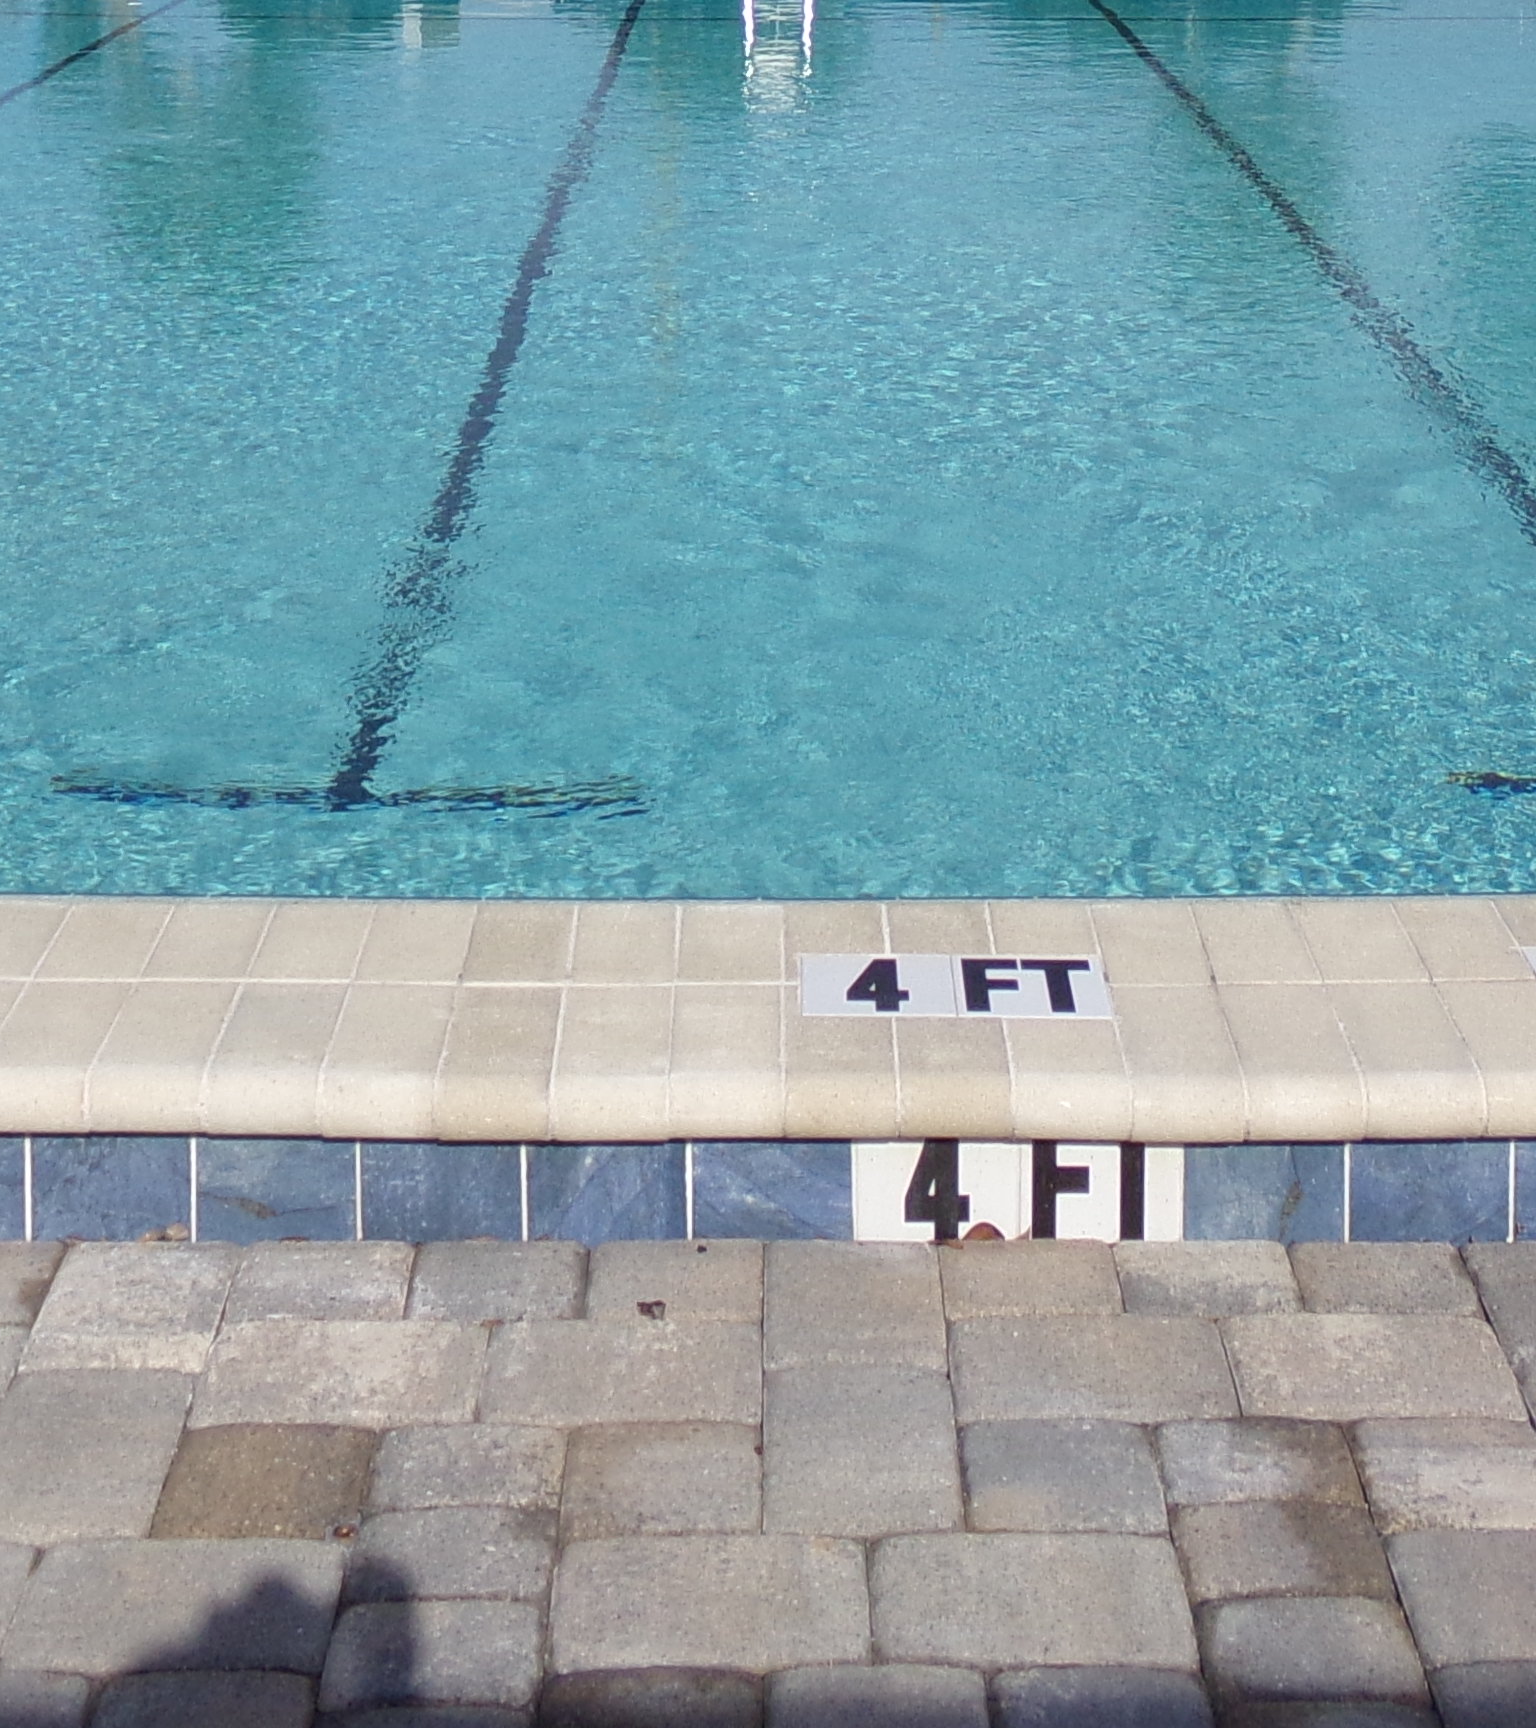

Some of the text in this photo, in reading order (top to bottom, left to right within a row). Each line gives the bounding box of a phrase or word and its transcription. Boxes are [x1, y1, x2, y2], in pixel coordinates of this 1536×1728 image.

[846, 958, 1090, 1013] 4 FT
[904, 1138, 970, 1239] 4
